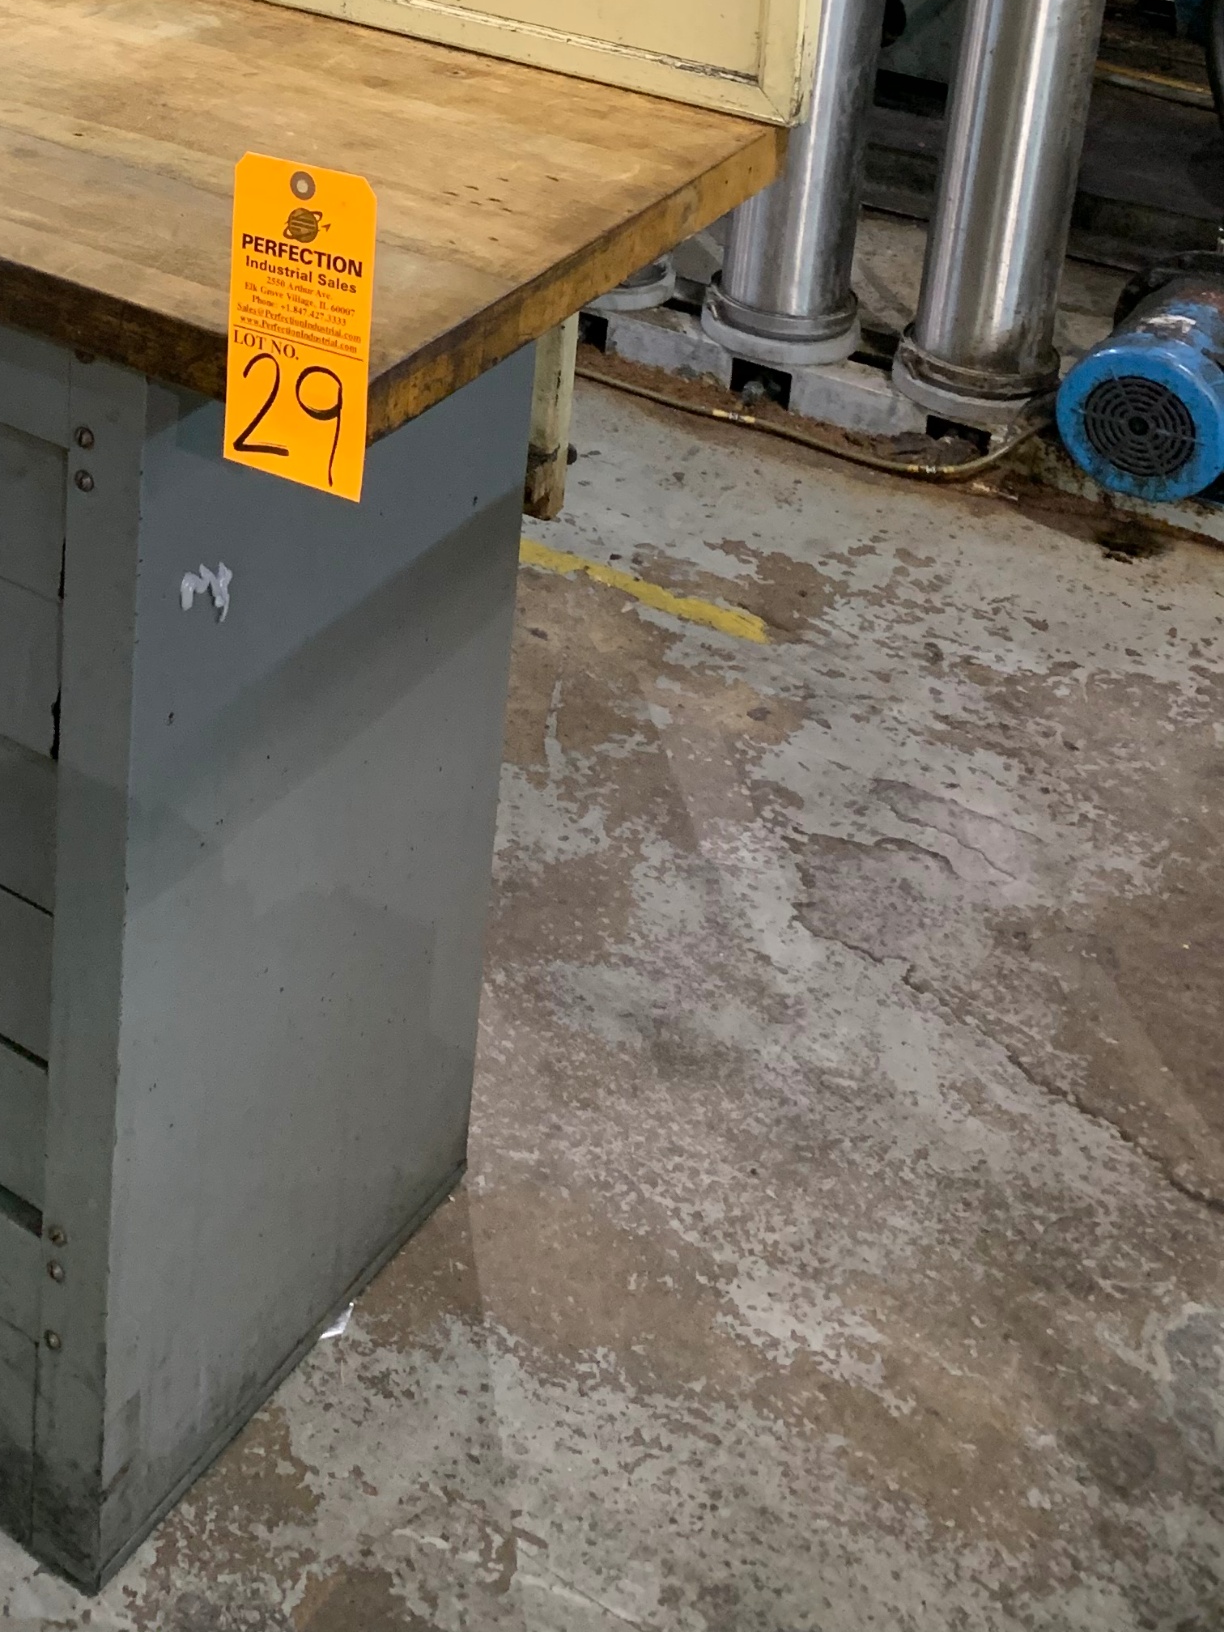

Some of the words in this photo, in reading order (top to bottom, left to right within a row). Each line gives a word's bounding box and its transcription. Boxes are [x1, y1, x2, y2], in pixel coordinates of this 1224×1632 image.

[242, 233, 363, 278] PERFECTION
[244, 281, 258, 292] Elk
[260, 286, 284, 299] Grove
[246, 255, 313, 283] Industrial
[317, 273, 357, 294] Sales
[288, 282, 314, 295] Arthur
[233, 329, 266, 350] LOT
[271, 339, 299, 361] NO.
[233, 352, 344, 487] 29
